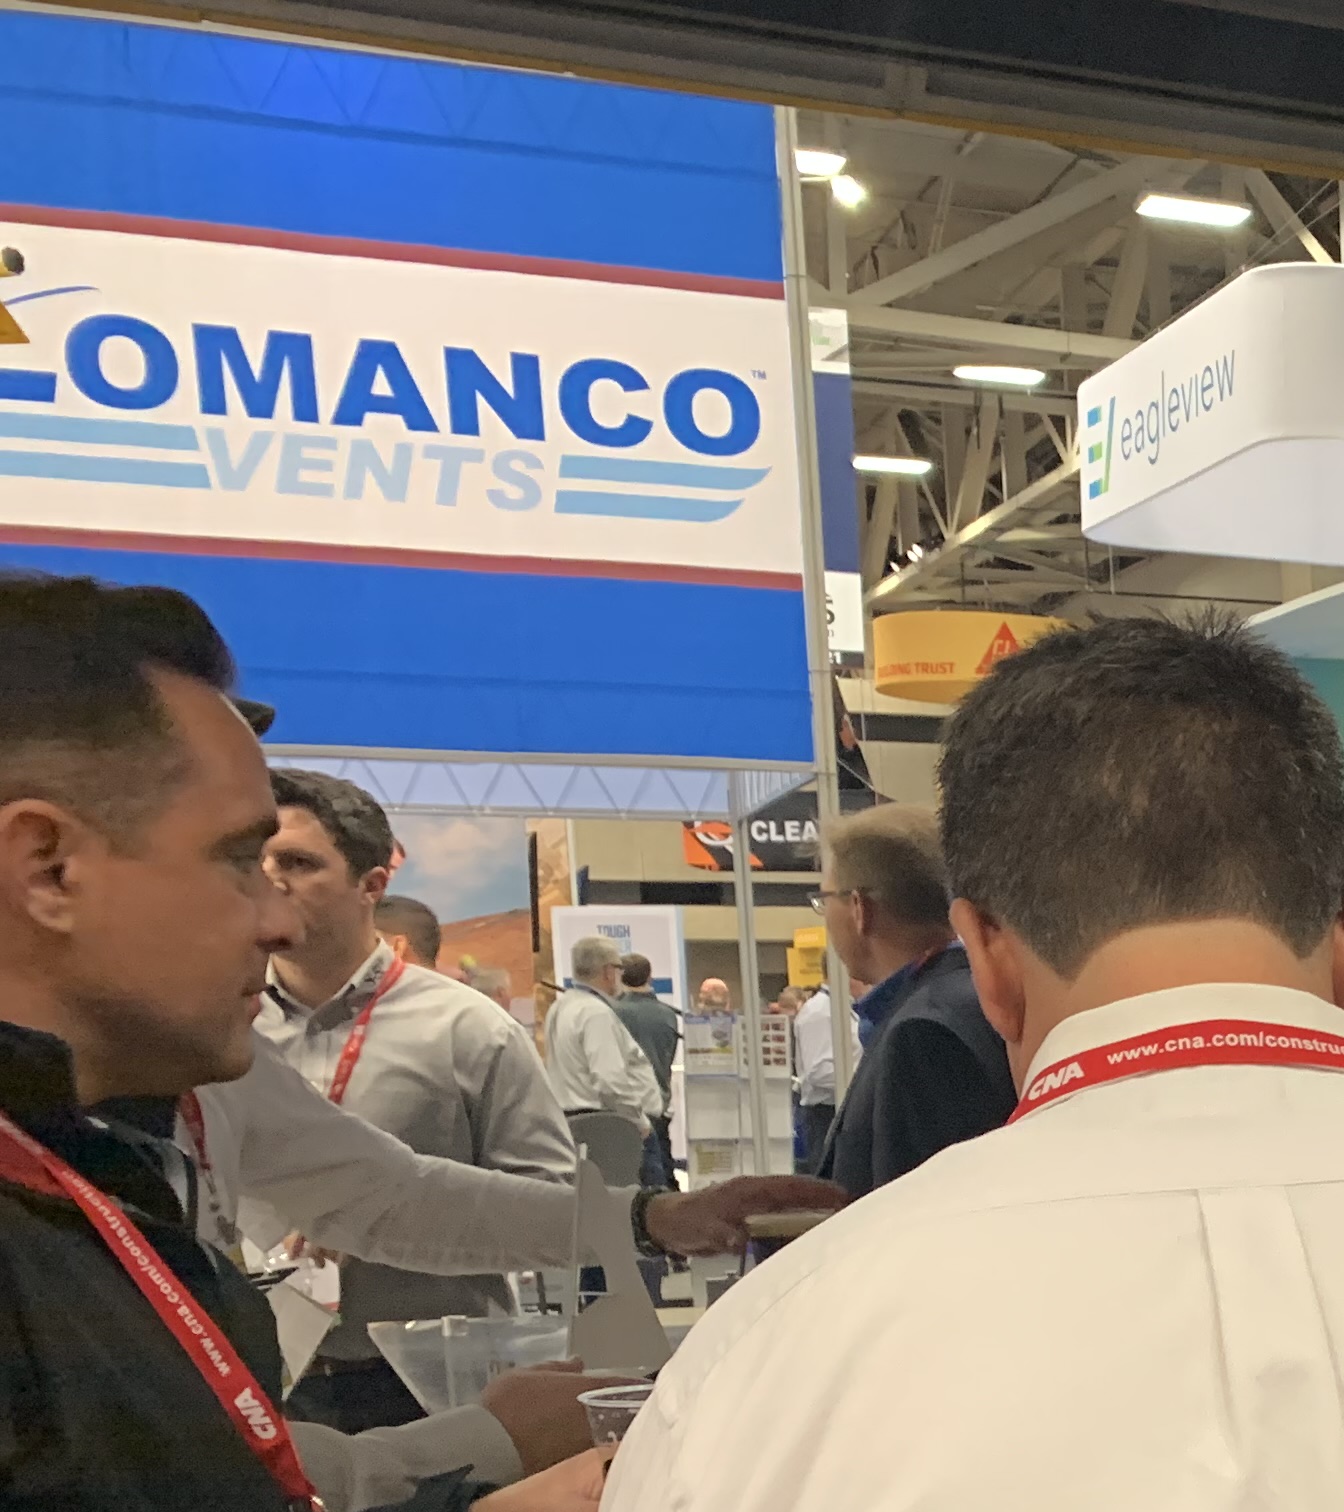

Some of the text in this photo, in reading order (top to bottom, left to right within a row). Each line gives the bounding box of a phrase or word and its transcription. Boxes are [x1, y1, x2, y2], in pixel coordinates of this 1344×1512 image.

[1120, 350, 1236, 464] eagleview
[207, 427, 545, 511] VENTS
[915, 661, 954, 675] TRUST
[597, 924, 631, 938] TOUGH
[1028, 1062, 1084, 1100] CNA
[234, 1387, 277, 1440] CNA
